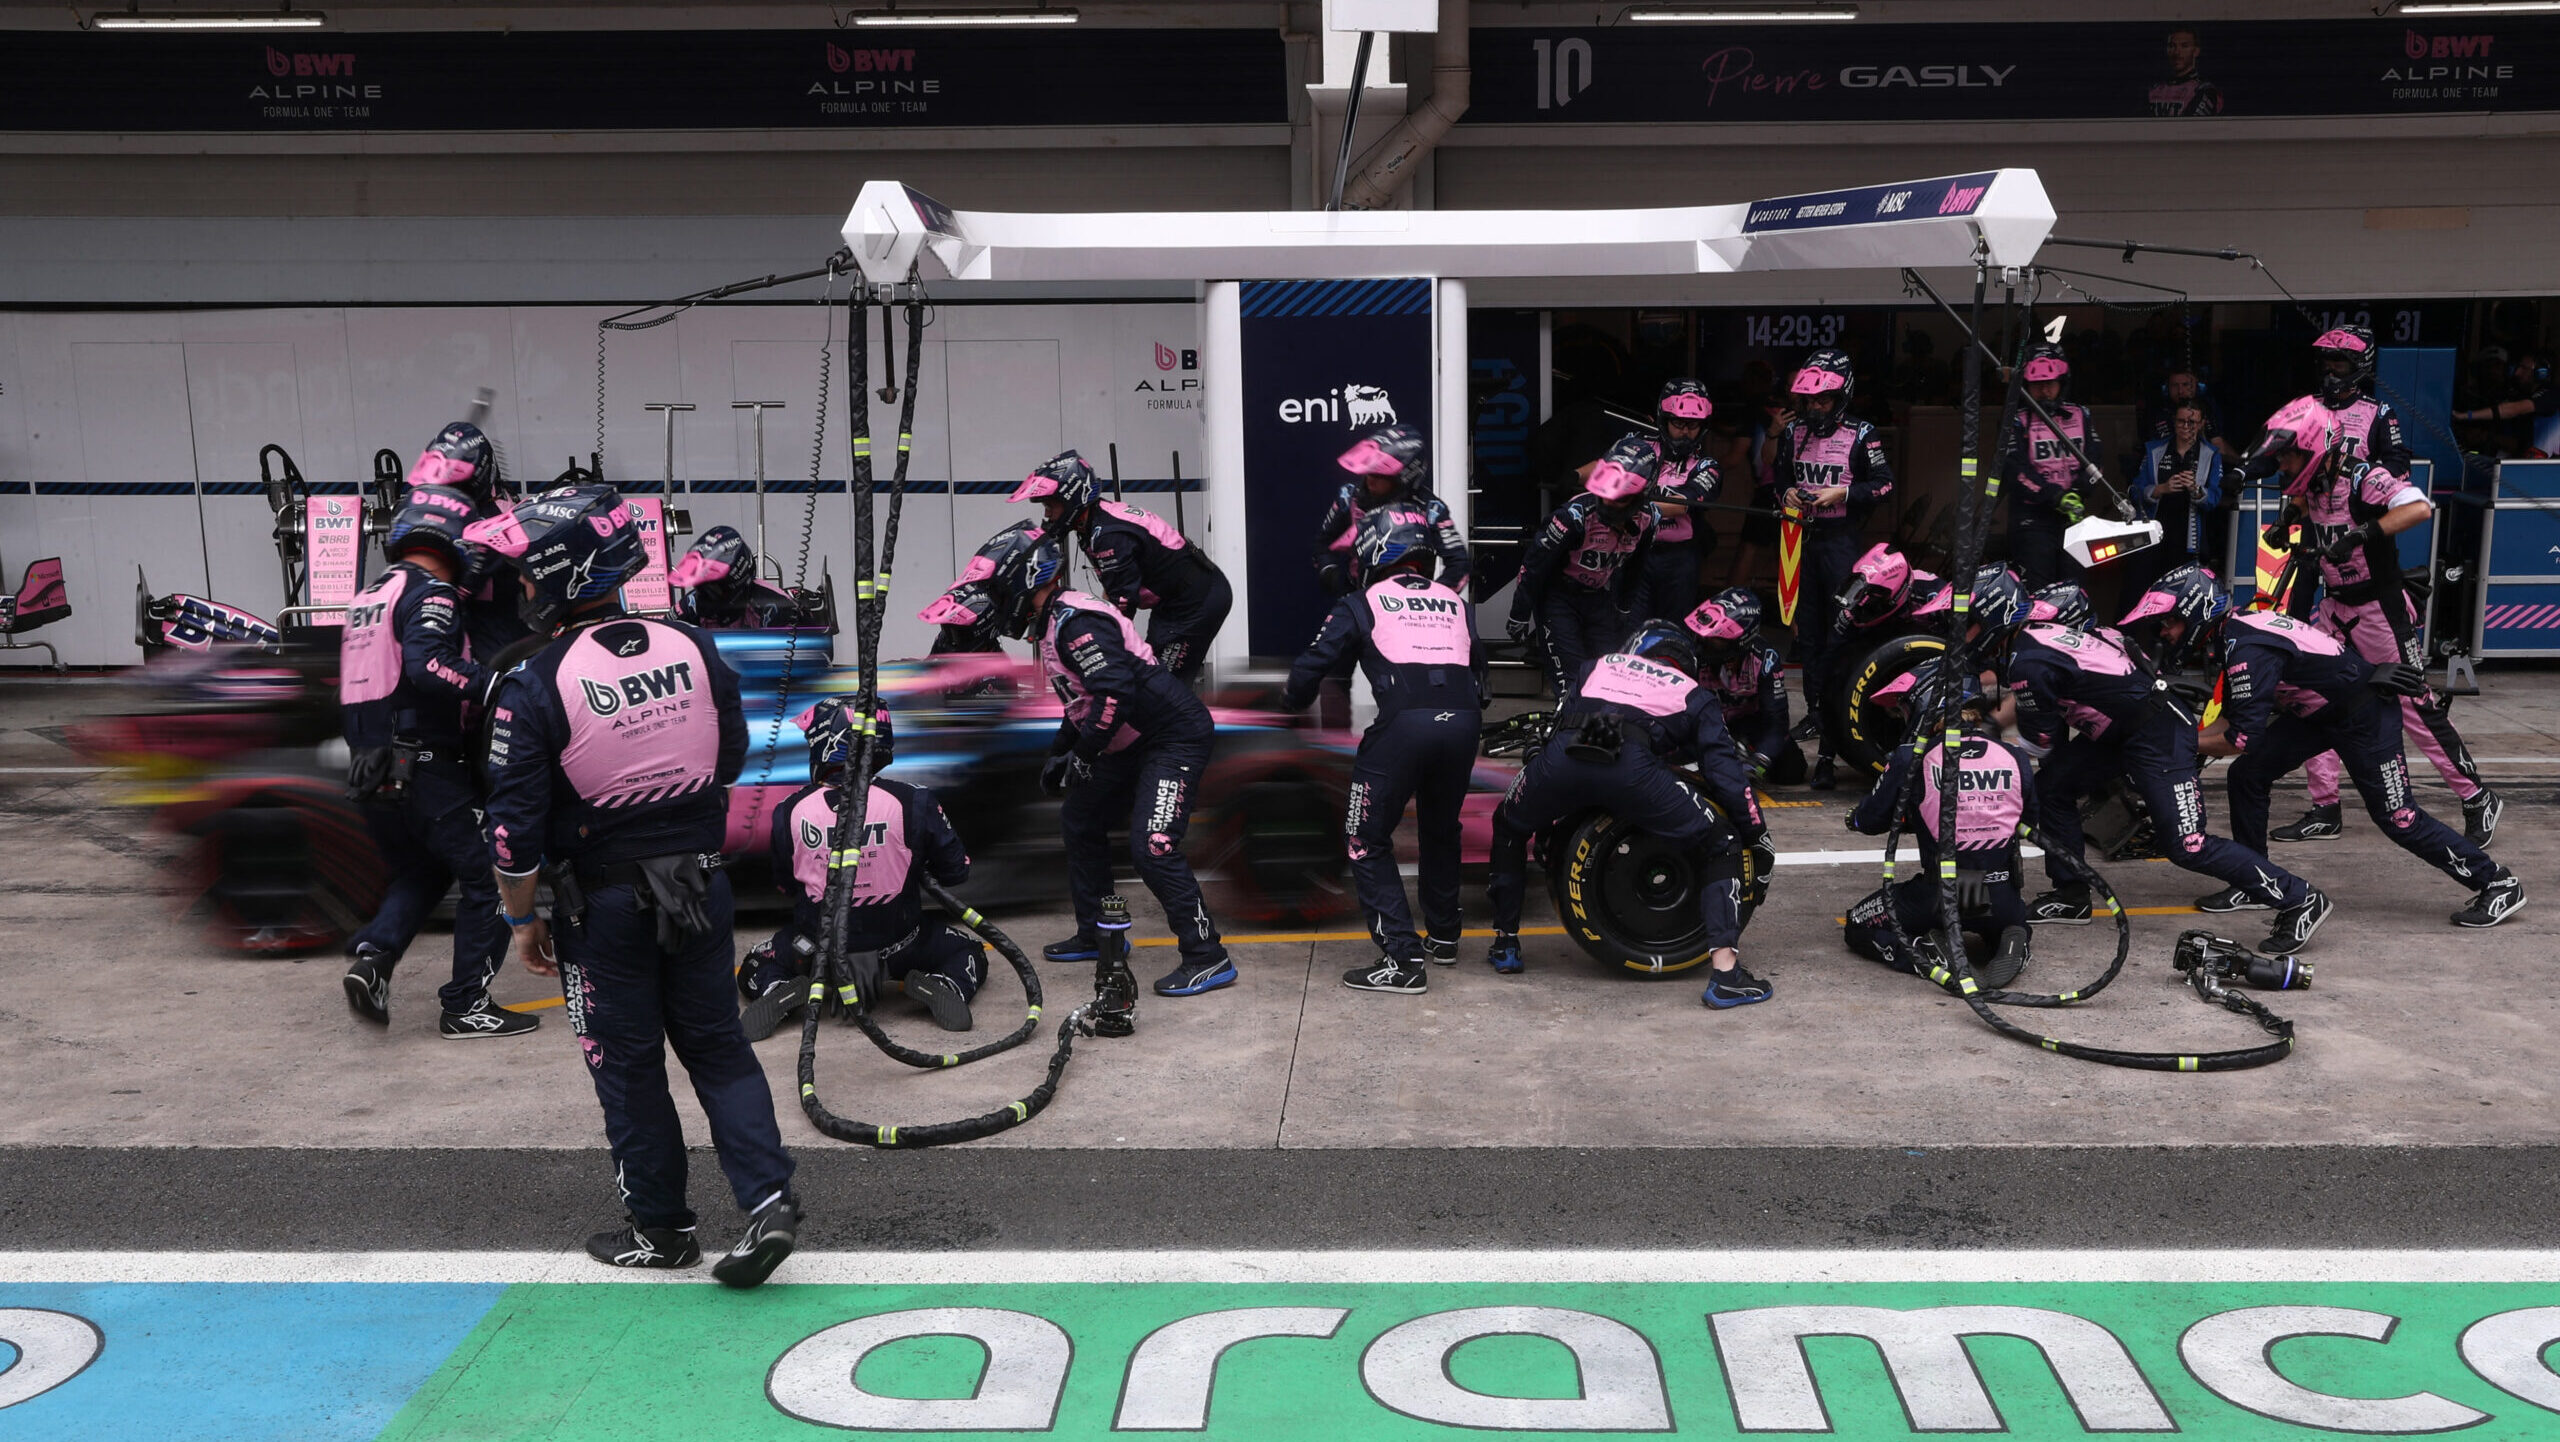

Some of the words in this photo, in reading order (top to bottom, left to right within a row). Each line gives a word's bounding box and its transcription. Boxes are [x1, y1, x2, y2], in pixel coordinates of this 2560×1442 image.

[2430, 34, 2495, 58] BWT
[293, 53, 356, 76] BWT
[853, 49, 916, 72] BWT
[2381, 65, 2514, 80] ALPINE
[1533, 37, 1592, 109] 10
[1702, 46, 1829, 108] Pierre
[1839, 64, 2017, 88] GASLY
[249, 85, 382, 98] ALPINE
[807, 79, 940, 94] ALPINE
[2392, 88, 2438, 99] FORMULA
[2472, 86, 2498, 98] TEAM
[263, 106, 310, 118] FORMULA
[344, 106, 370, 118] TEAM
[821, 102, 867, 113] FORMULA
[901, 102, 927, 112] TEAM
[1884, 190, 1913, 214] MSC
[1952, 186, 1985, 214] BWT
[1147, 399, 1192, 410] FORMULA
[1278, 388, 1340, 423] eni
[1794, 462, 1845, 486] BWT
[315, 517, 354, 530] BWT
[547, 505, 577, 520] MSC
[330, 535, 351, 545] BRB
[996, 530, 1016, 544] MSC
[1977, 567, 2001, 578] MSC
[2173, 566, 2195, 579] MSC
[1407, 595, 1459, 617] BWT
[1397, 614, 1455, 624] ALPINE
[1627, 659, 1686, 685] BWT
[618, 661, 697, 708] BWT
[1849, 660, 1879, 724] ZERO
[611, 700, 692, 731] ALPINE
[671, 715, 688, 728] TEAM
[1851, 727, 1865, 741] P
[1958, 770, 2013, 791] BWT
[2380, 762, 2400, 811] CHANGE
[2390, 759, 2405, 798] WORLD
[1152, 779, 1170, 832] CHANGE
[1164, 781, 1179, 823] WORLD
[1348, 782, 1359, 834] CHANGE
[1354, 784, 1364, 826] WORLD
[2173, 783, 2194, 835] CHANGE
[2185, 781, 2200, 823] WORLD
[1568, 838, 1591, 920] ZERO
[1852, 896, 1883, 920] HANGE
[1581, 927, 1602, 941] P
[562, 961, 582, 1034] CHANGE
[571, 964, 585, 1017] WORLD
